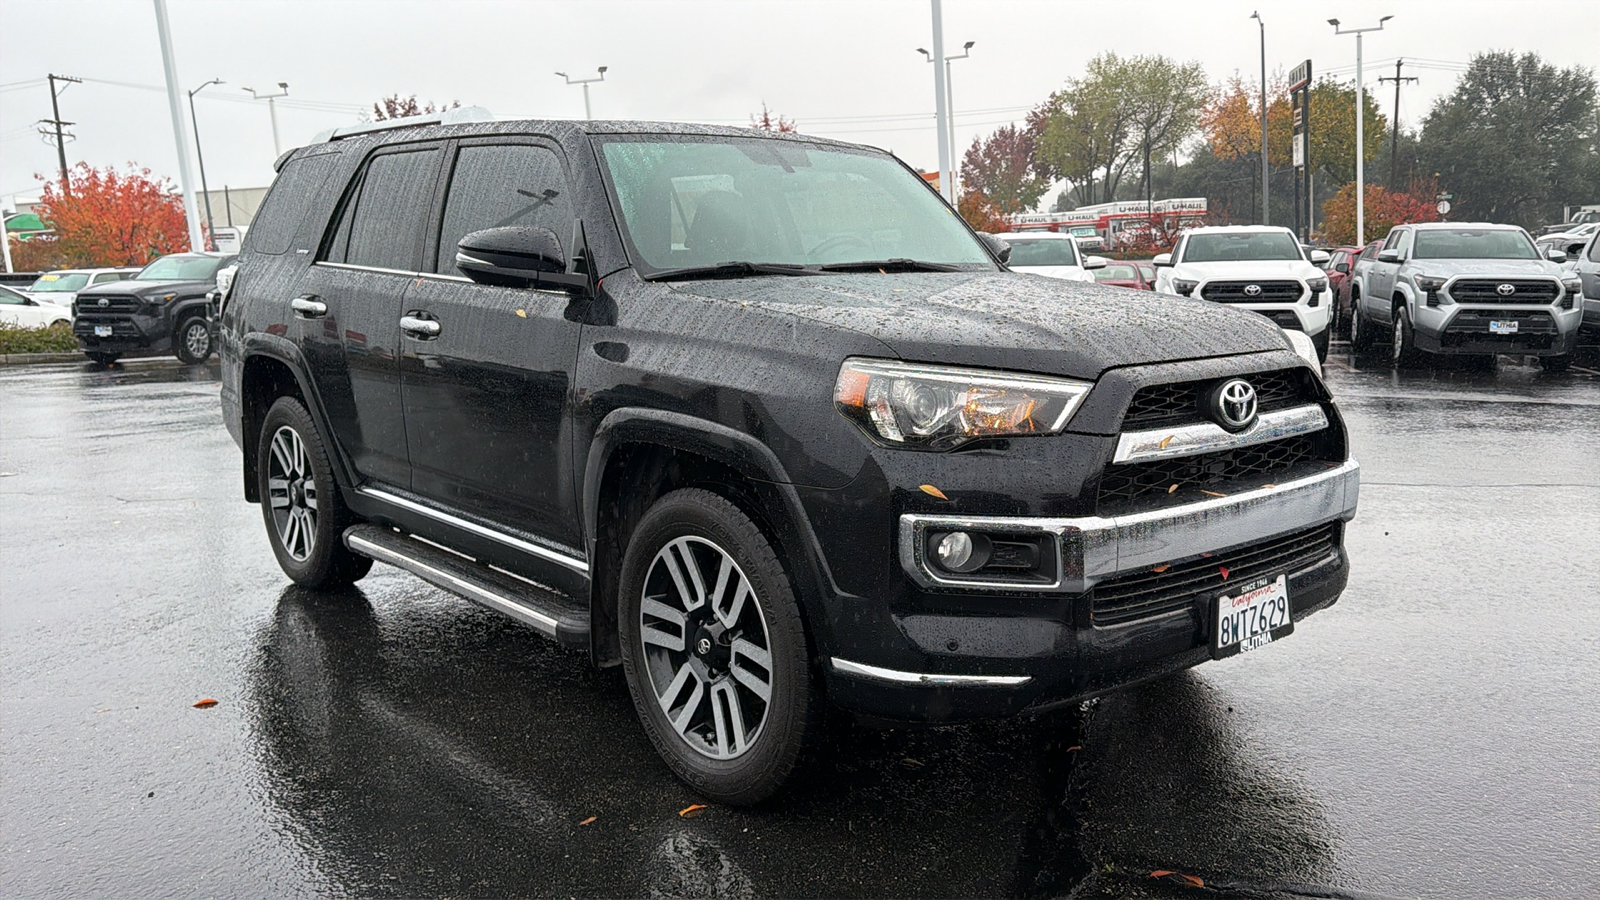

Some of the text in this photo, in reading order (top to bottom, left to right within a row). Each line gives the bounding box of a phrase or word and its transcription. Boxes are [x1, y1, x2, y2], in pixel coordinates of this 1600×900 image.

[1231, 584, 1276, 608] California
[1241, 581, 1256, 594] SINCE
[1221, 596, 1286, 645] 8WTZ629
[1247, 631, 1273, 651] LITHIA
